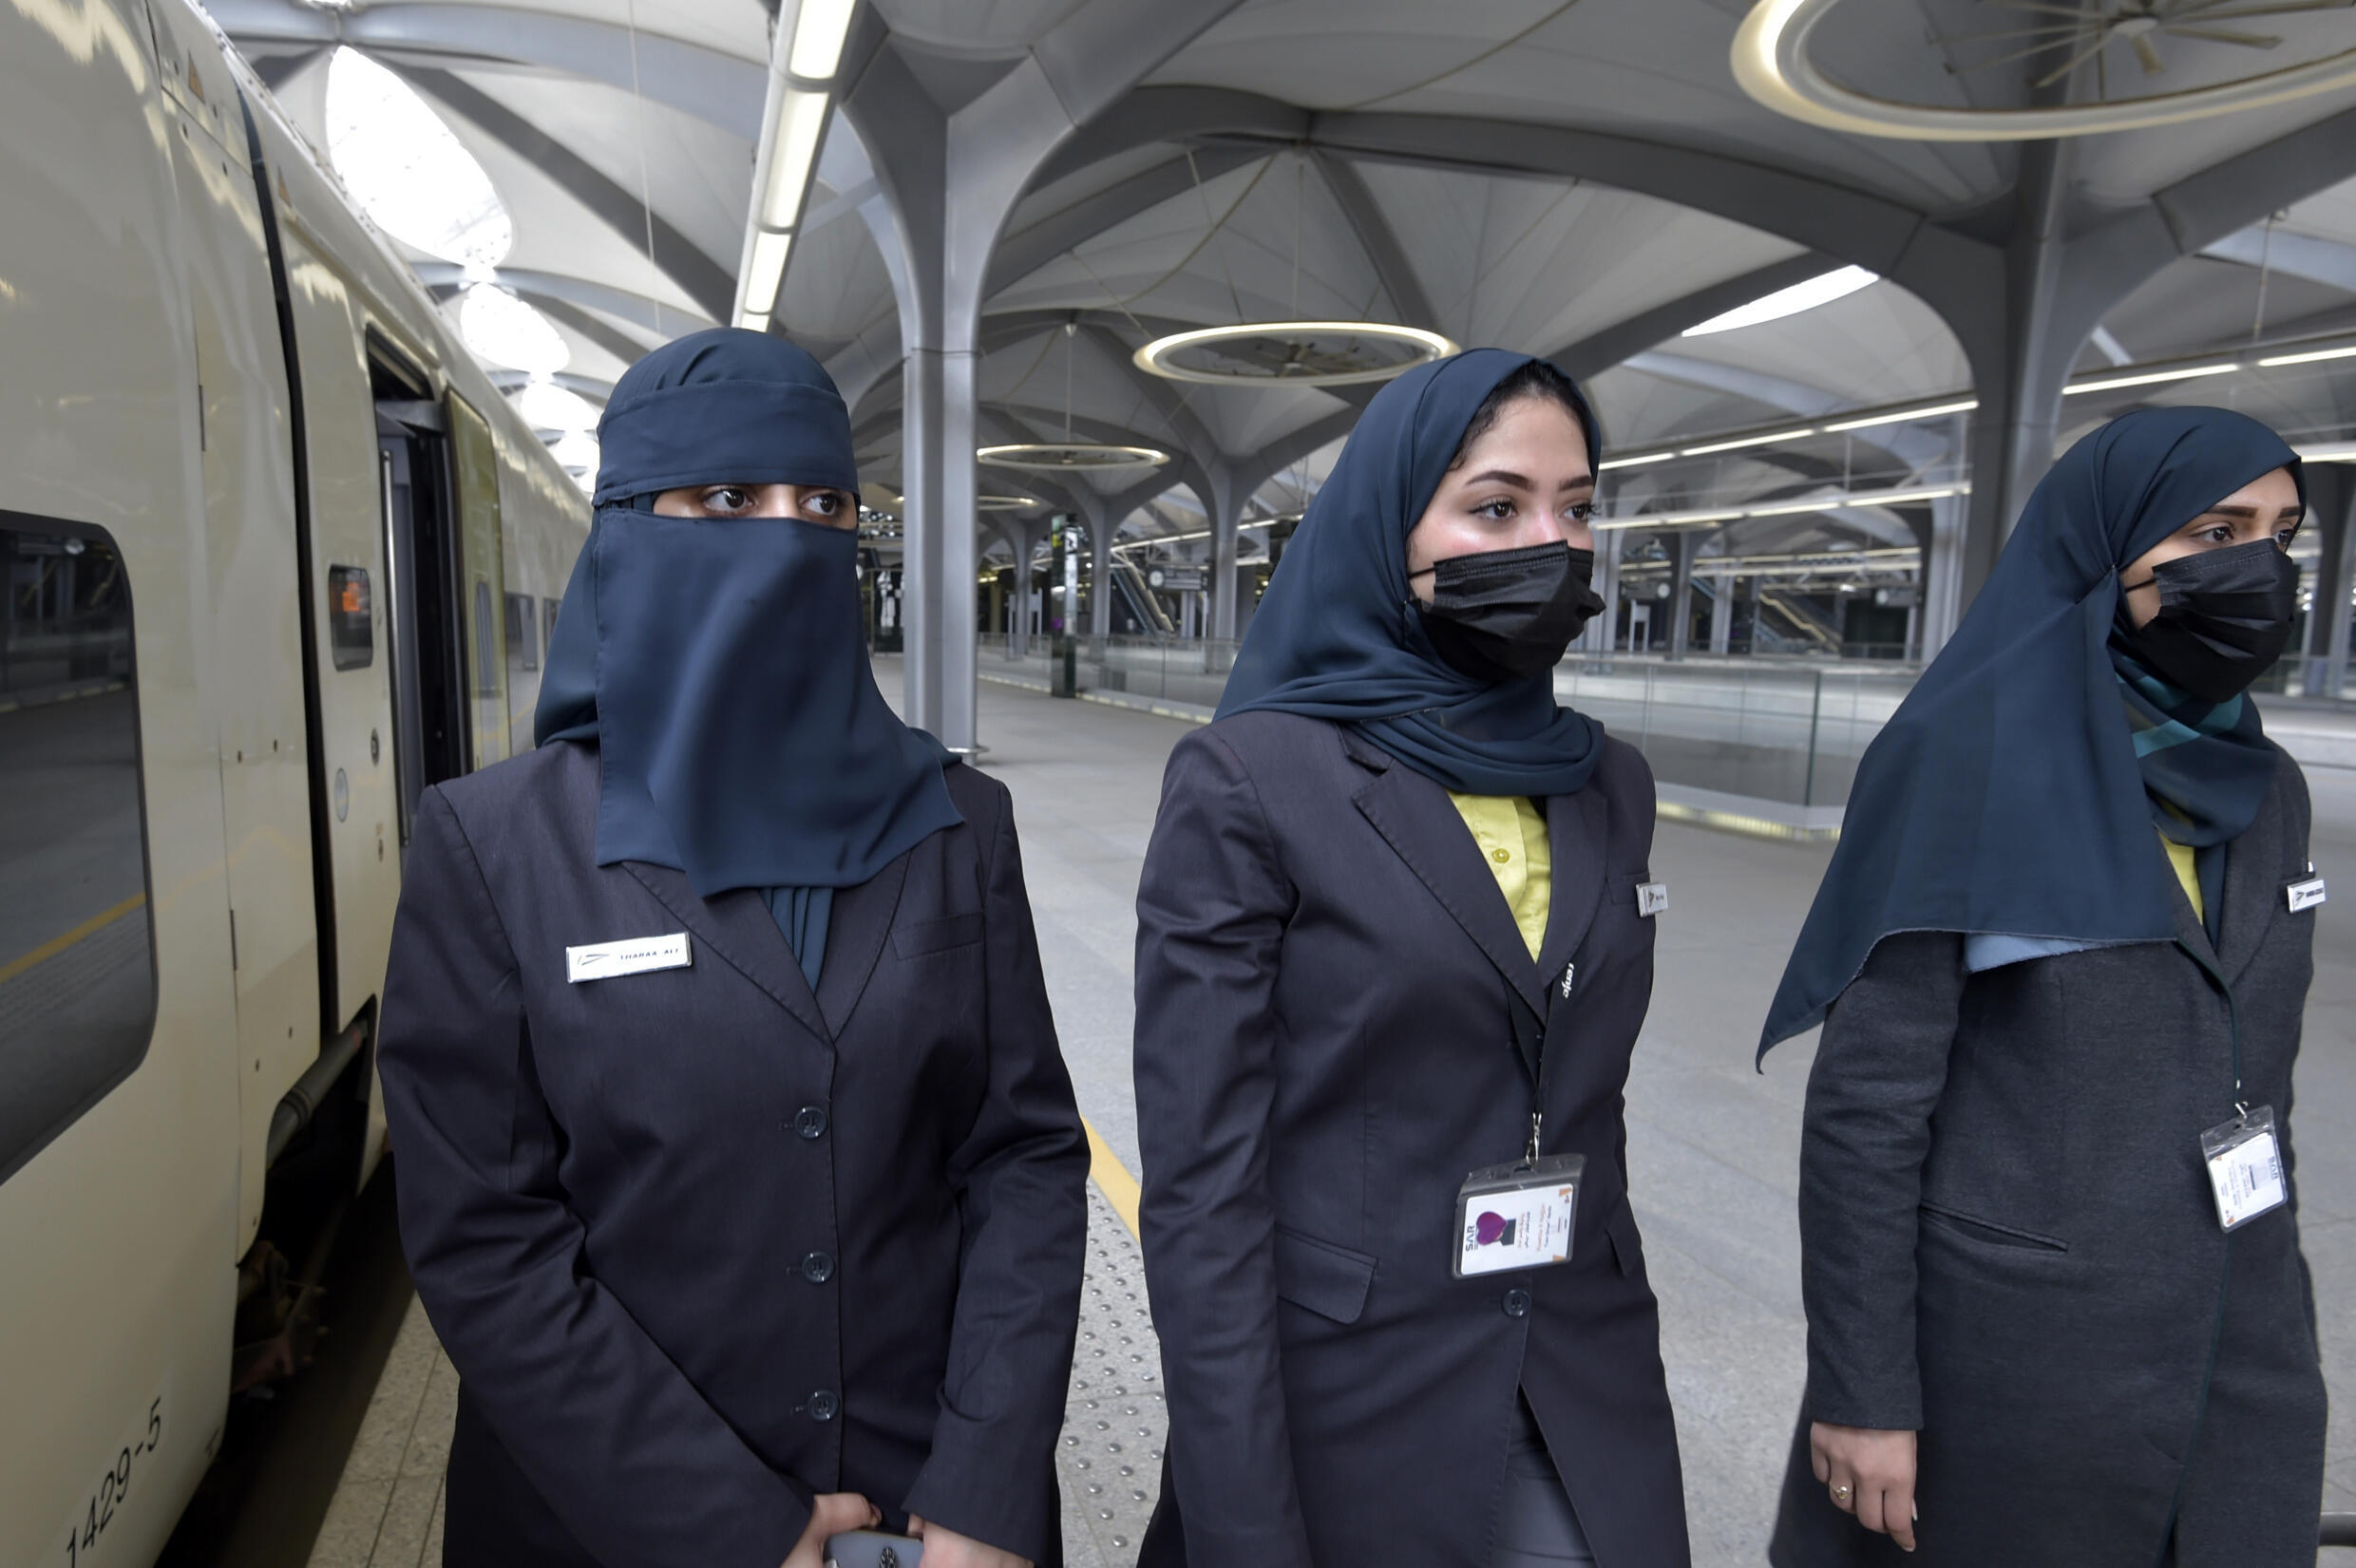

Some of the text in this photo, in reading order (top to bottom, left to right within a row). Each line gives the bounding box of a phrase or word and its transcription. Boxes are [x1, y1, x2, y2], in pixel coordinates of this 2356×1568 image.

[1561, 962, 1575, 999] renfe
[1465, 1224, 1475, 1253] SAR
[66, 1394, 162, 1568] 1429-5
